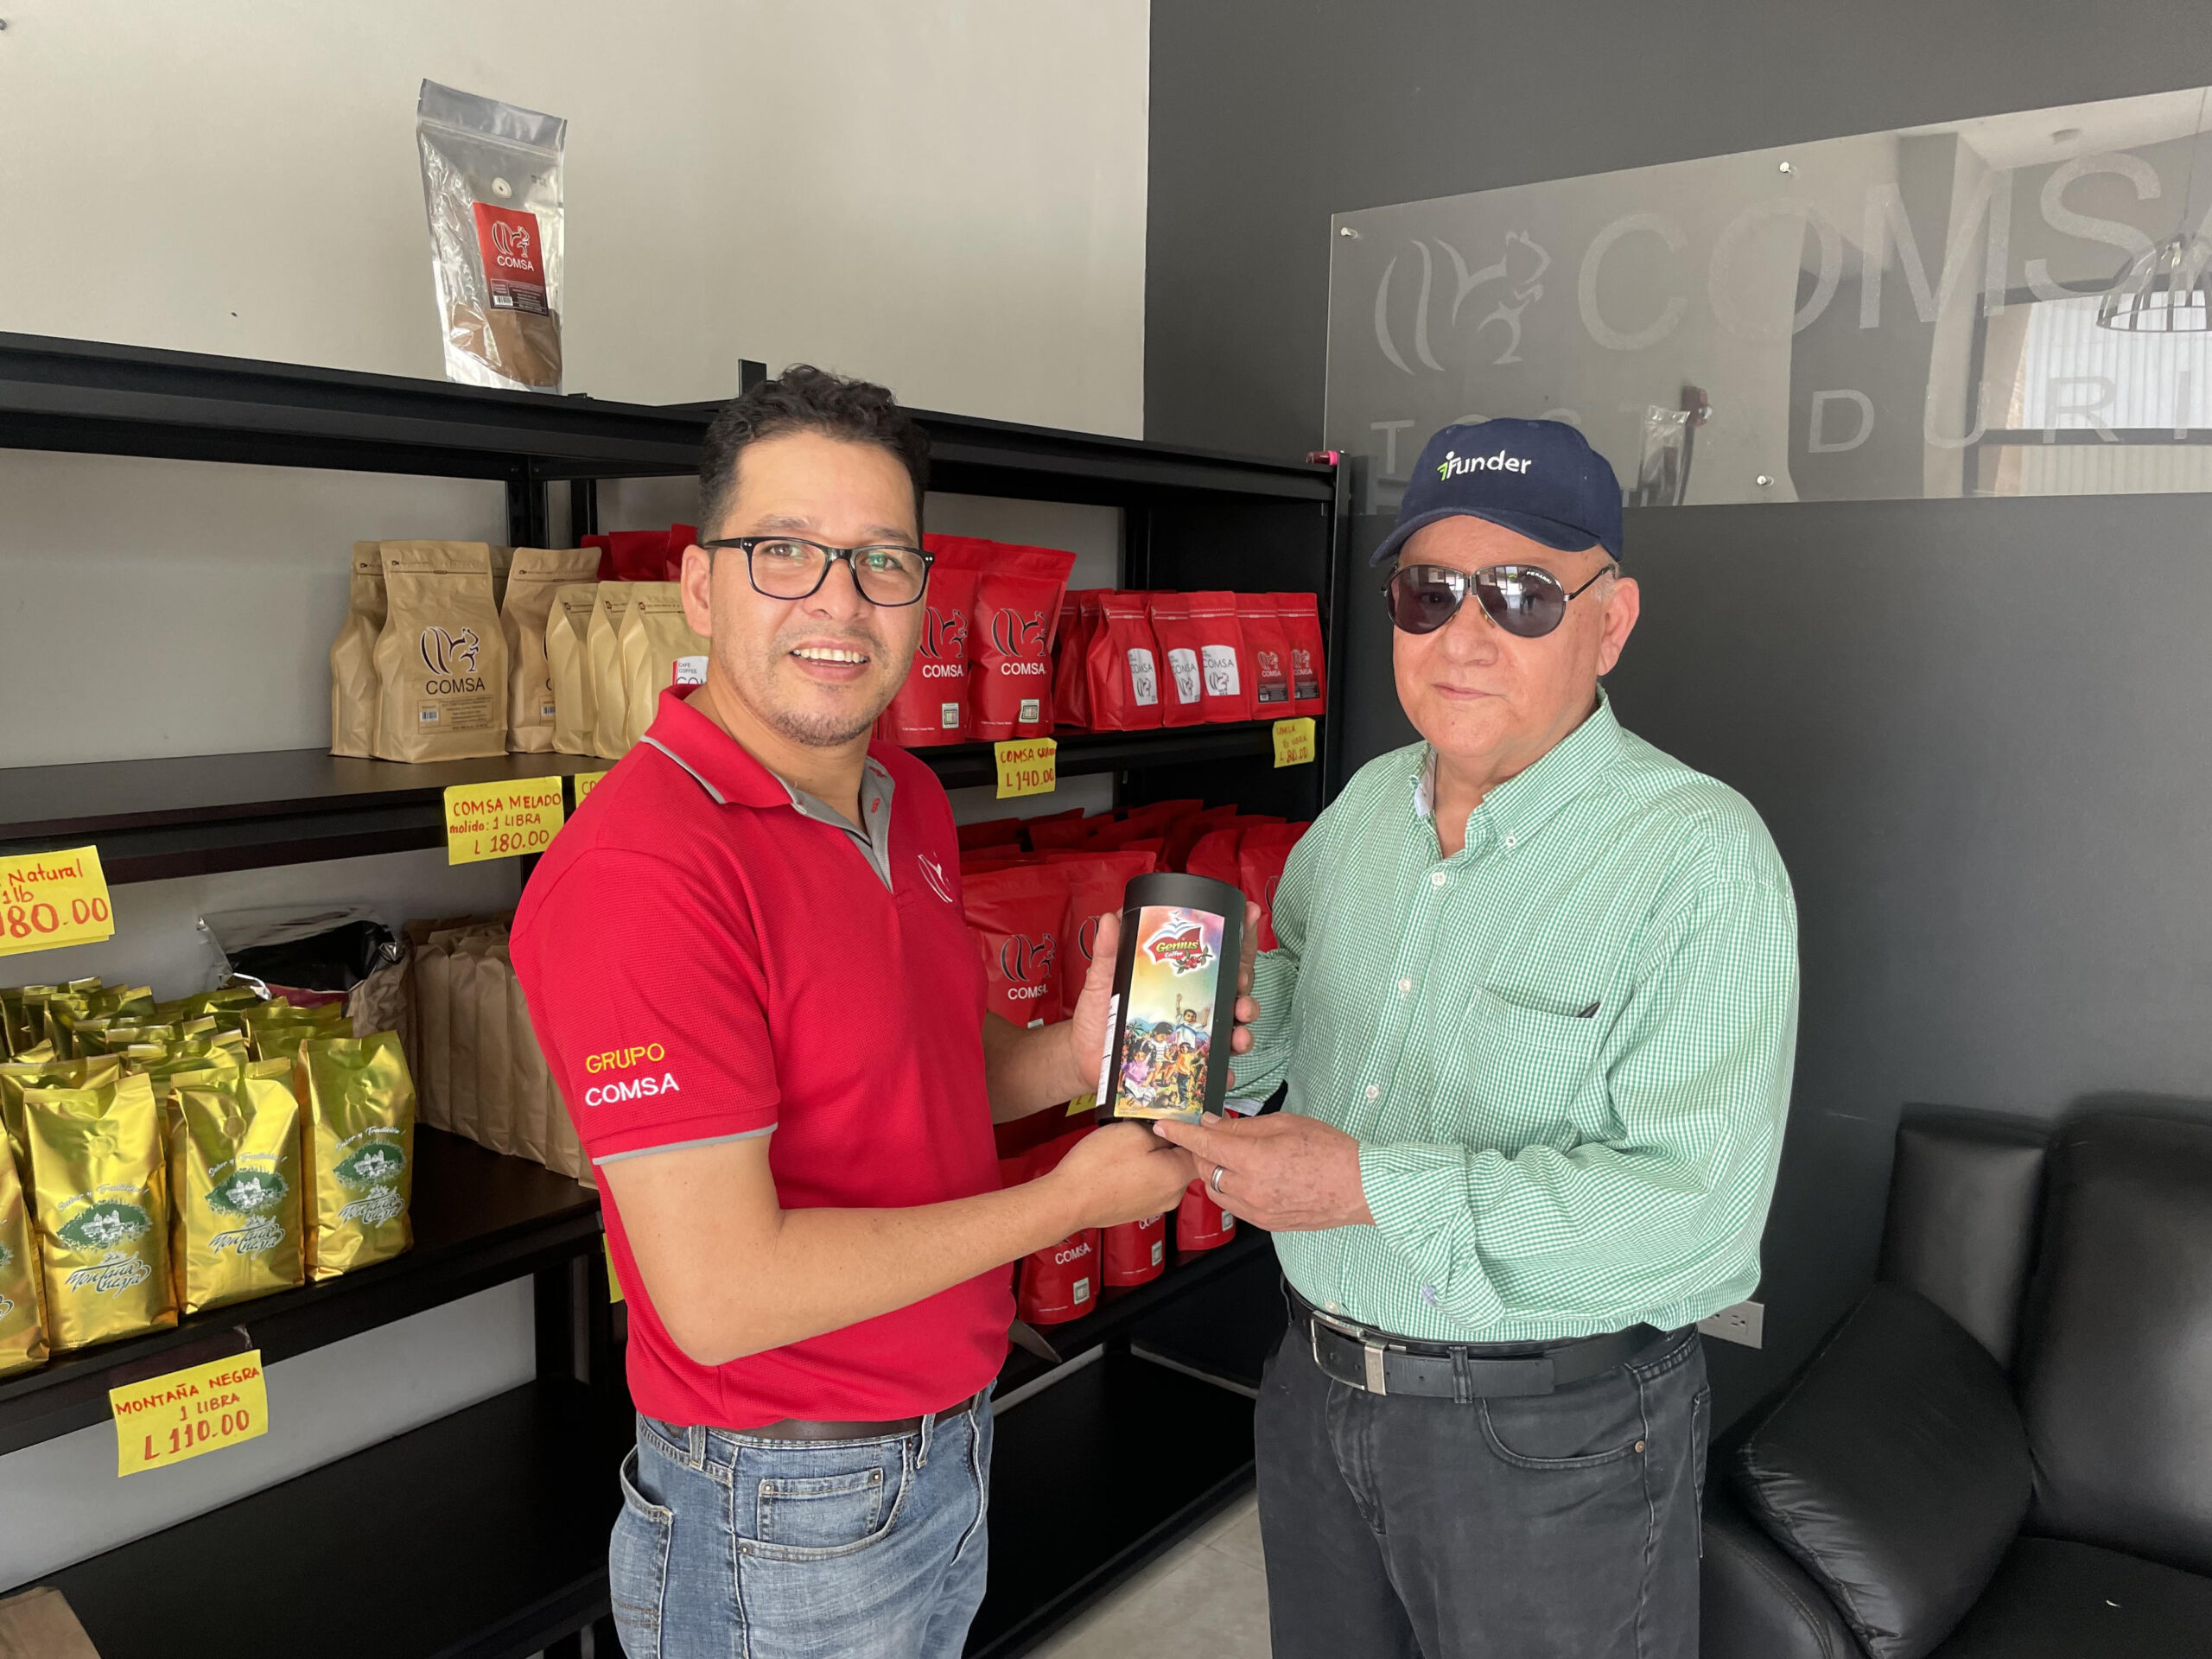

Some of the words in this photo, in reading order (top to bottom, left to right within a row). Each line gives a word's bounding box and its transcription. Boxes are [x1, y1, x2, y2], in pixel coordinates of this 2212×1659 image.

[1578, 149, 2212, 350] COMS
[497, 255, 534, 271] COMSA
[922, 664, 963, 677] COMSA
[1001, 663, 1046, 676] COMSA
[1204, 658, 1235, 669] COMSA
[426, 677, 486, 695] COMSA
[1001, 748, 1035, 764] COMSA
[1006, 772, 1014, 787] L
[1016, 768, 1054, 791] 140.00
[454, 798, 504, 817] COMSA
[509, 792, 562, 810] MELADO
[449, 819, 490, 835] molido:
[493, 817, 499, 830] 1
[505, 813, 542, 828] LIBRA
[474, 840, 480, 855] L
[490, 830, 550, 854] 180.00
[8, 858, 84, 887] Natural
[1155, 940, 1199, 953] Genius
[585, 1043, 664, 1074] GRUPO
[585, 1072, 680, 1106] COMSA
[1055, 1243, 1090, 1264] COMSA
[115, 1383, 200, 1416] MONTAÑA
[208, 1367, 260, 1389] NEGRA
[179, 1405, 188, 1421] 1
[197, 1392, 240, 1414] LIBRA
[143, 1433, 161, 1461] L
[168, 1409, 250, 1454] 110.00
